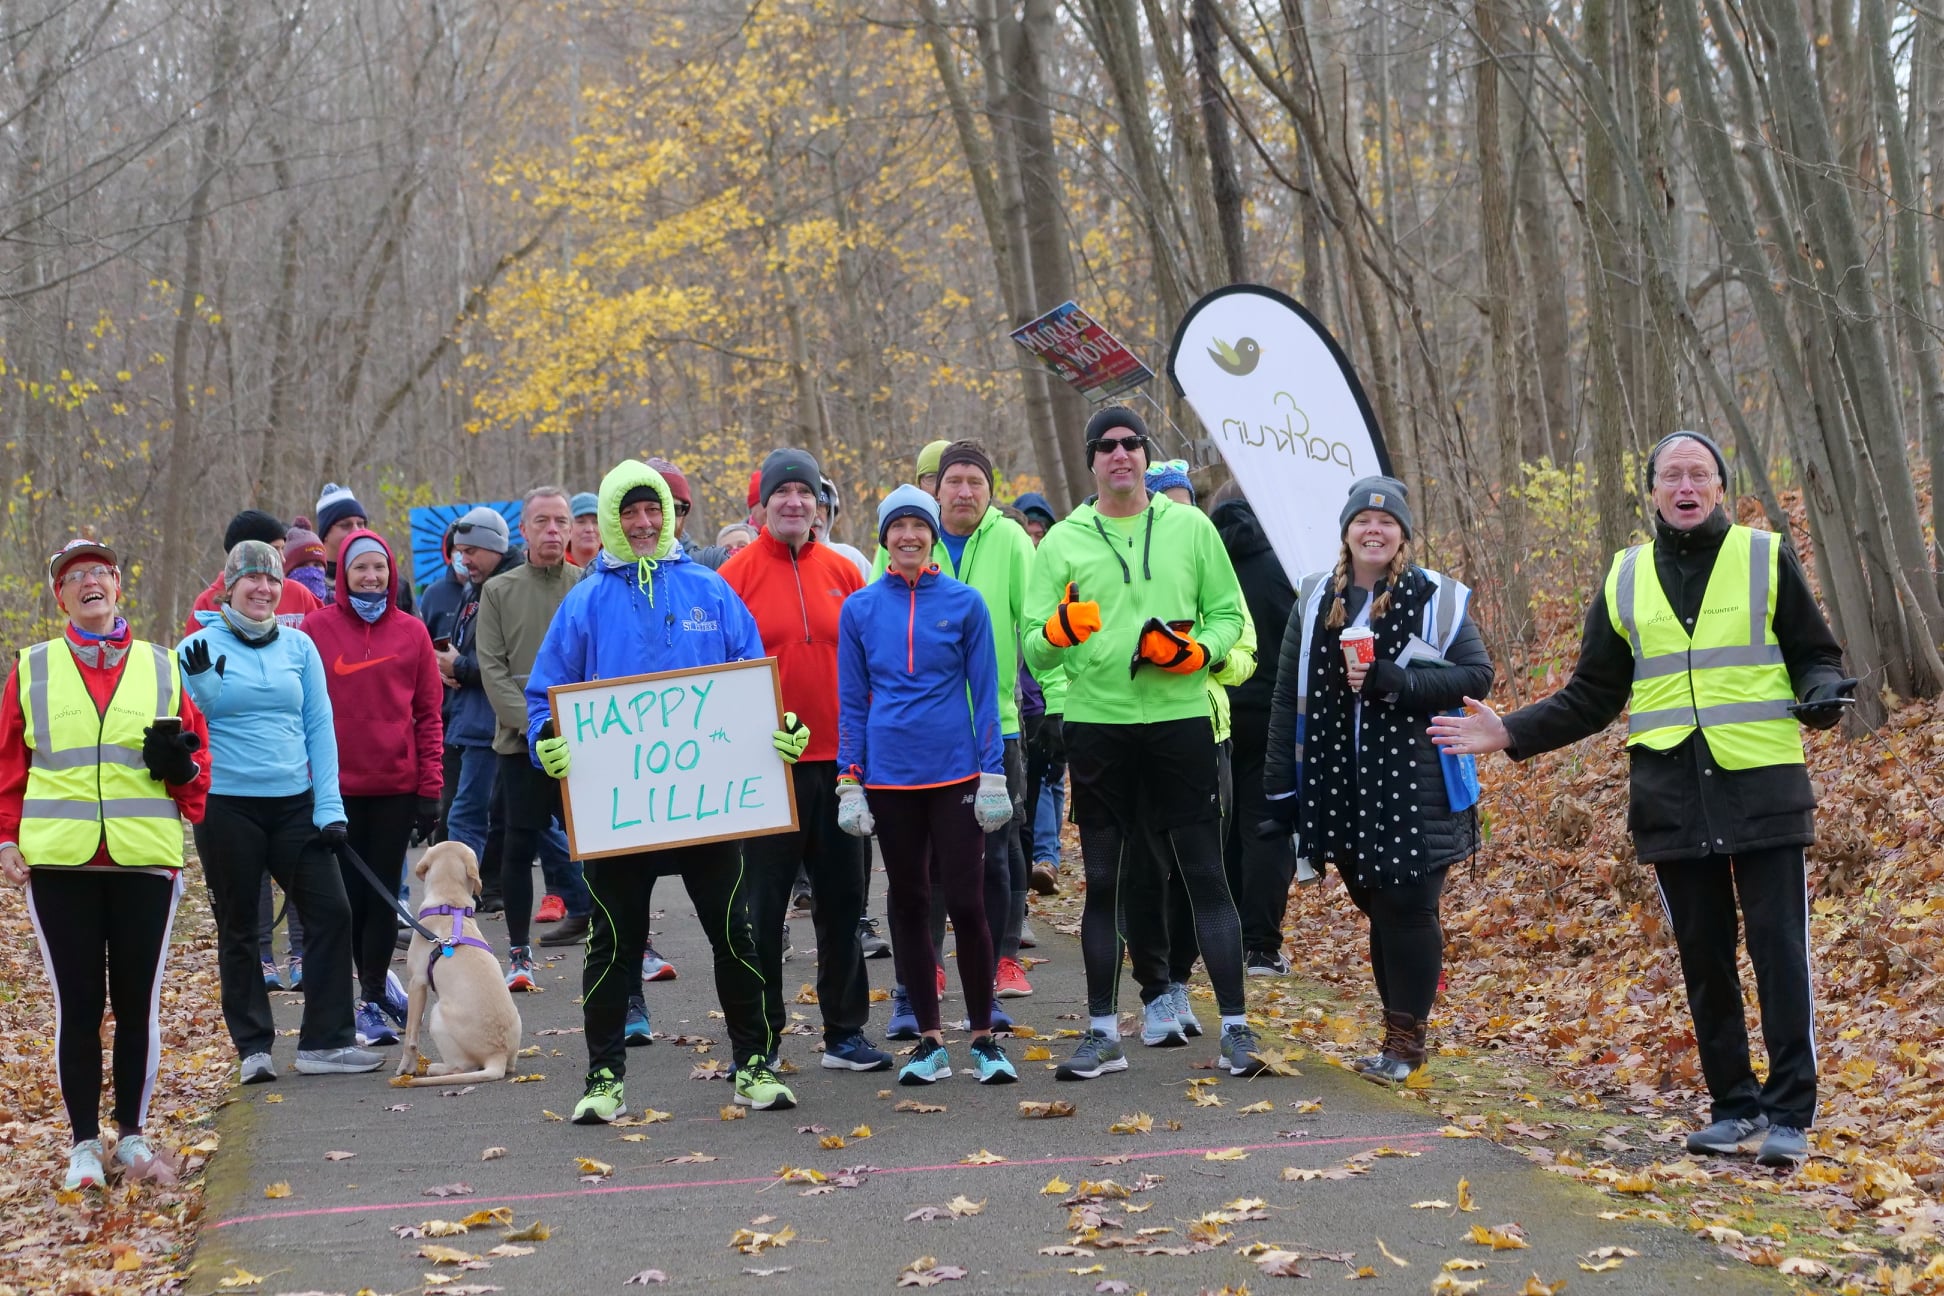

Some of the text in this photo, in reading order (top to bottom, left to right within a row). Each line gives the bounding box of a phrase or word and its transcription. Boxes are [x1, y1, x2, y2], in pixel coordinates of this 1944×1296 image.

[1015, 311, 1092, 355] MURALS
[1067, 333, 1121, 369] MOVE
[1703, 605, 1739, 615] VOLUNTEER
[574, 680, 714, 743] HAPPY
[612, 776, 765, 831] LILLIE
